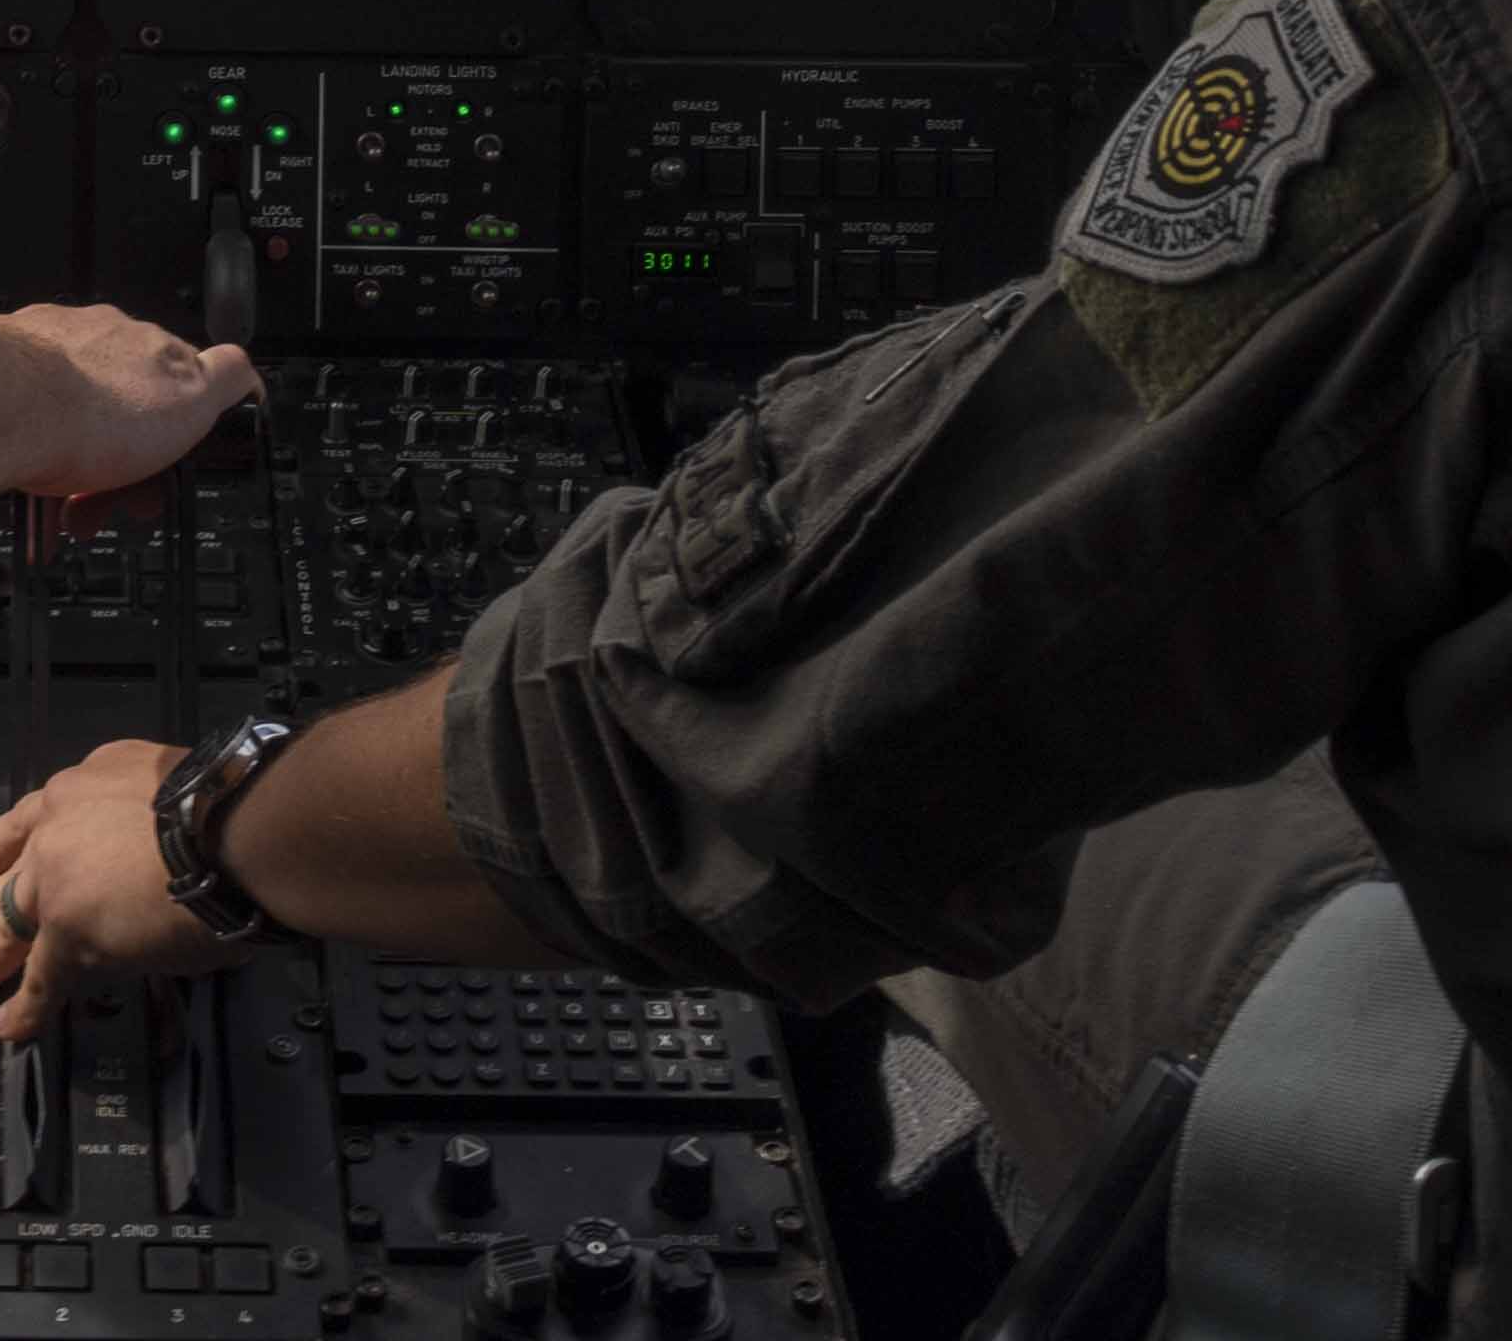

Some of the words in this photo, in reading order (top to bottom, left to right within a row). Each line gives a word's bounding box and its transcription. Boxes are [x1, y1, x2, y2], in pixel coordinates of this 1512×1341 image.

[209, 67, 245, 80] GEAR
[381, 65, 440, 79] LANDING
[449, 66, 496, 79] LIGHTS
[782, 70, 859, 83] HYDRAULIC
[408, 84, 453, 95] MOTORS
[672, 101, 719, 111] BRAKES
[844, 98, 885, 109] ENGINE
[892, 99, 931, 110] PUMPS
[926, 119, 963, 130] BOOST
[211, 125, 241, 136] NOSE
[142, 155, 173, 166] LEFT
[280, 156, 313, 167] RIGHT
[644, 252, 710, 269] 3011
